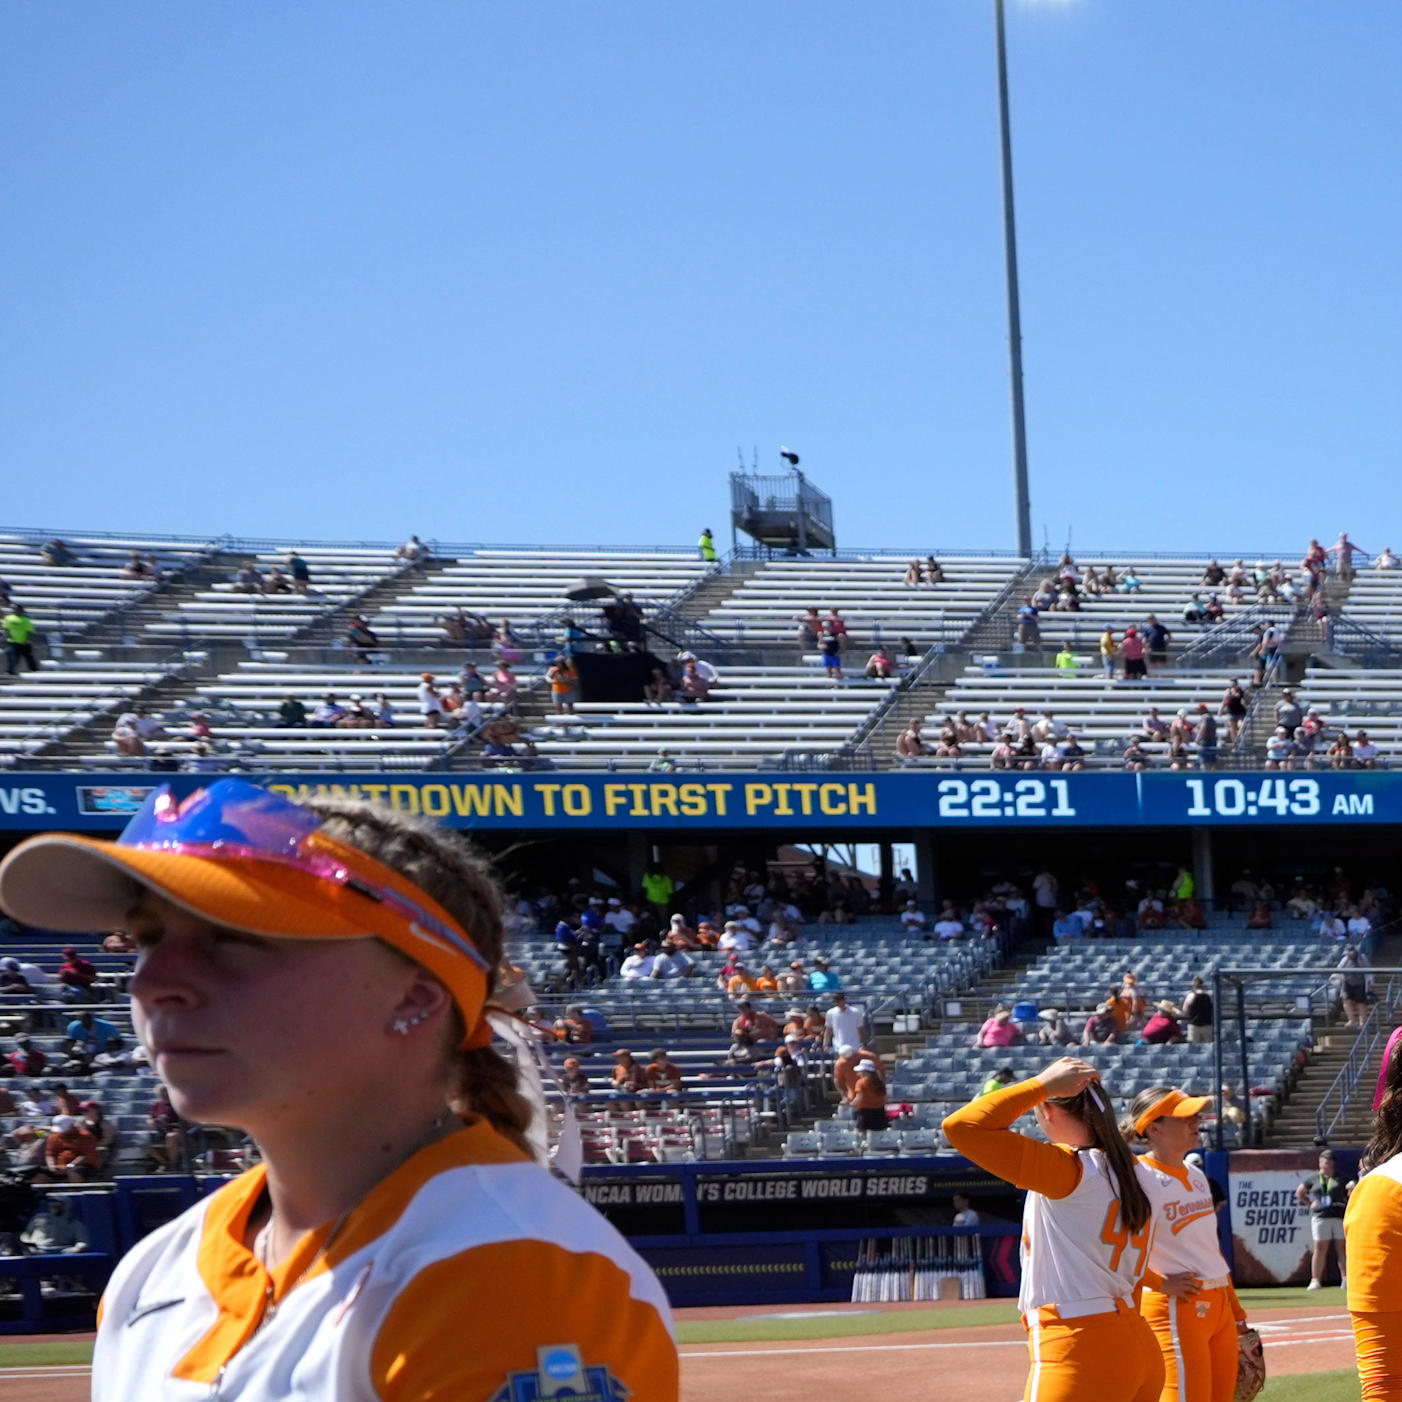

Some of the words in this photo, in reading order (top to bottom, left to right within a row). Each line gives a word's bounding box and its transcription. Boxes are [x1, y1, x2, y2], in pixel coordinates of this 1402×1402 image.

[0, 788, 57, 815] VS.
[534, 784, 592, 816] TO
[604, 784, 732, 816] FIRST
[744, 783, 877, 815] PITCH
[937, 779, 1076, 817] 22:21
[1186, 779, 1320, 816] 10:43
[1332, 793, 1374, 815] AM
[584, 1186, 631, 1203] NCAA
[635, 1183, 721, 1203] WOM'S
[724, 1181, 798, 1200] COLLEGE
[800, 1179, 862, 1198] WORLD
[866, 1177, 928, 1195] SERIES
[1239, 1181, 1253, 1189] THE
[1237, 1190, 1305, 1207] GREATE
[1244, 1209, 1296, 1226] SHOW
[1298, 1208, 1309, 1216] ON
[1258, 1227, 1297, 1244] DIRT
